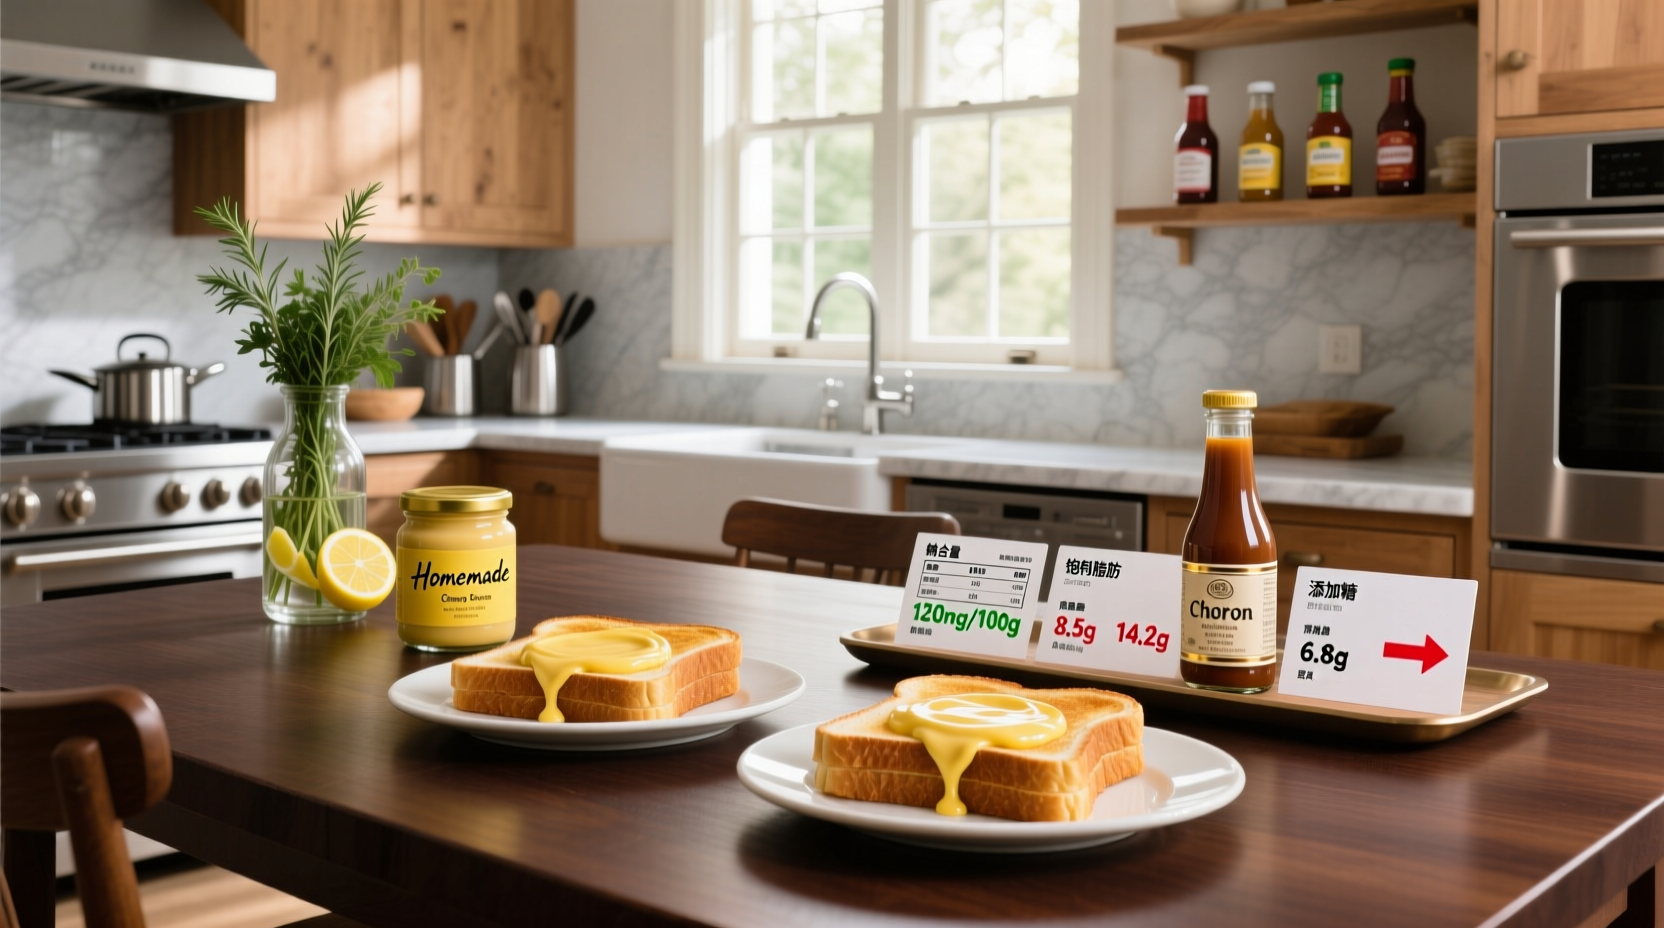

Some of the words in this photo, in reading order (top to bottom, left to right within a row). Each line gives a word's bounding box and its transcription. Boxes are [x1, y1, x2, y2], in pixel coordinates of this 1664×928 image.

[411, 558, 510, 591] Homemade
[1308, 580, 1358, 601] 添加糖
[913, 602, 1021, 638] 120ng/100g
[1190, 600, 1253, 621] Choron
[1054, 615, 1096, 645] 8.5g
[1117, 622, 1170, 653] 14.2g
[1300, 641, 1348, 671] 6.8g
